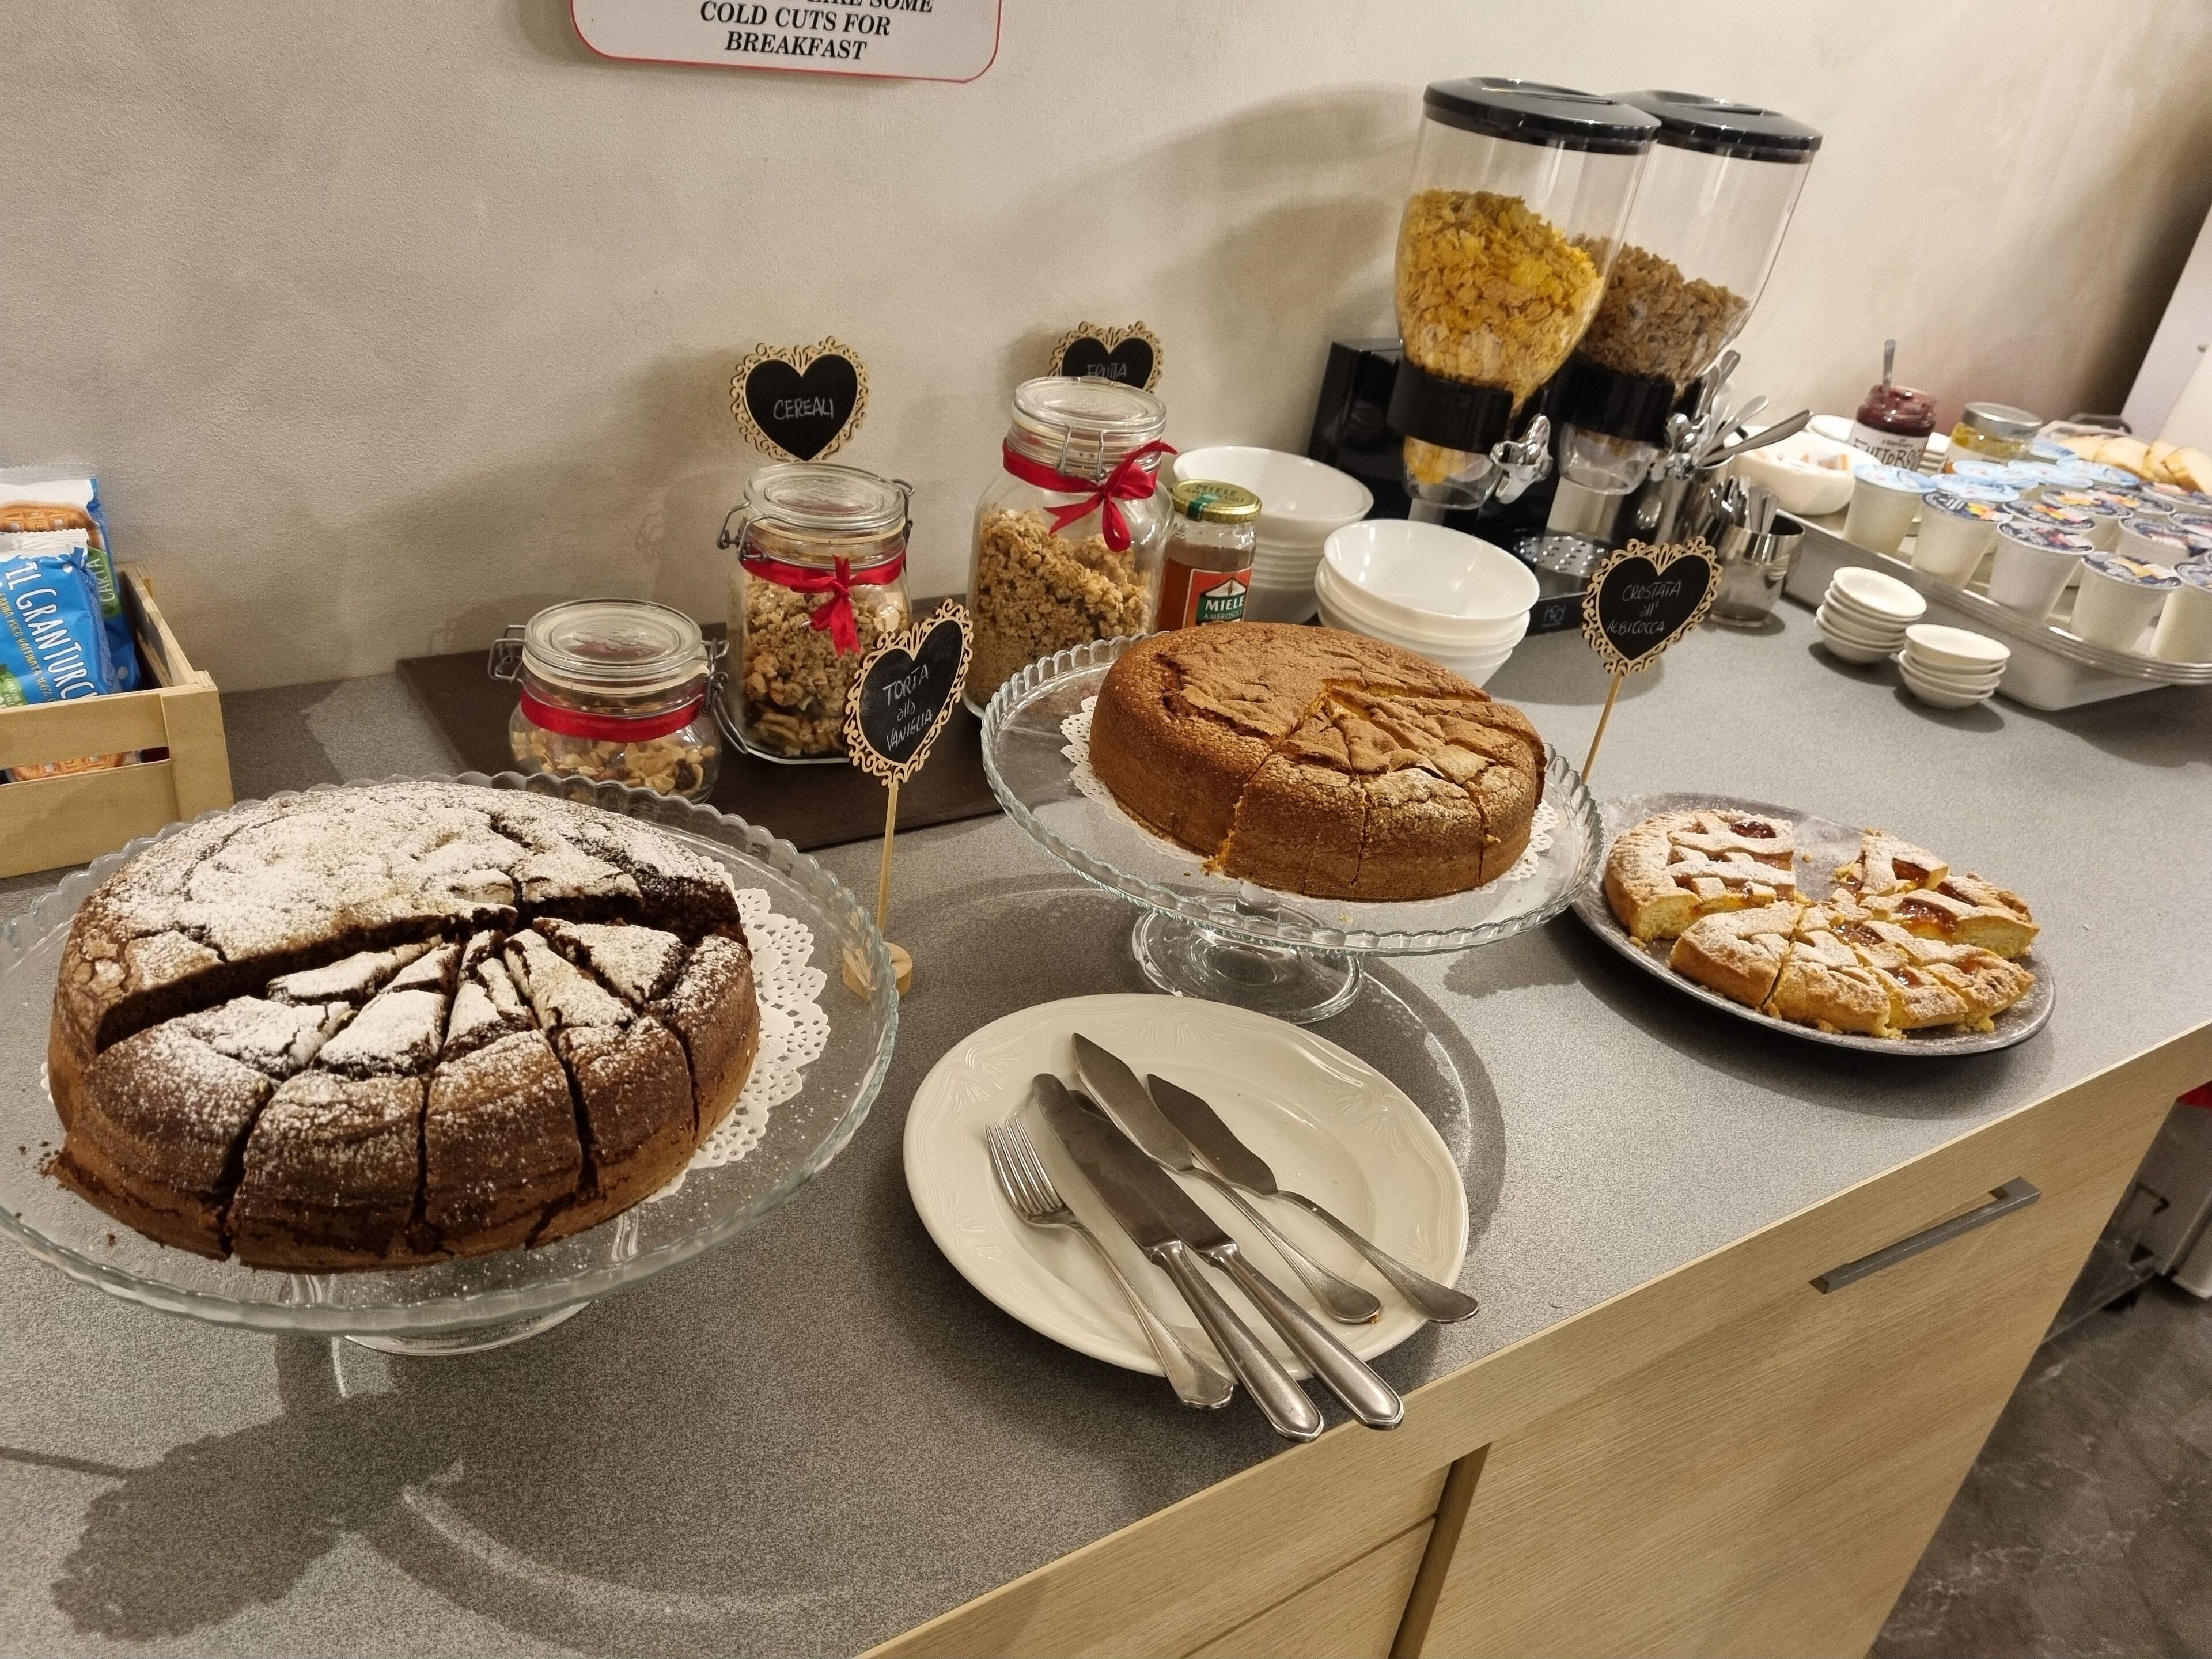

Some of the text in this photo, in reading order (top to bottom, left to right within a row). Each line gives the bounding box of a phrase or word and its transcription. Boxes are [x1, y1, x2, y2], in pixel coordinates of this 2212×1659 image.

[700, 1, 891, 35] COLD CUTS FOR
[725, 31, 867, 59] BREAKFAST
[773, 397, 834, 419] CEREALI
[1196, 484, 1238, 496] MIELE
[5, 561, 42, 590] IL
[1622, 580, 1681, 601] CROSTATA
[1205, 595, 1245, 611] MIELE
[1203, 609, 1243, 620] AMBROSOLI
[1607, 619, 1665, 635] ALBICOCCA
[882, 664, 929, 706] TORTA
[897, 699, 916, 721] alla
[886, 709, 933, 751] VANIGLIA
